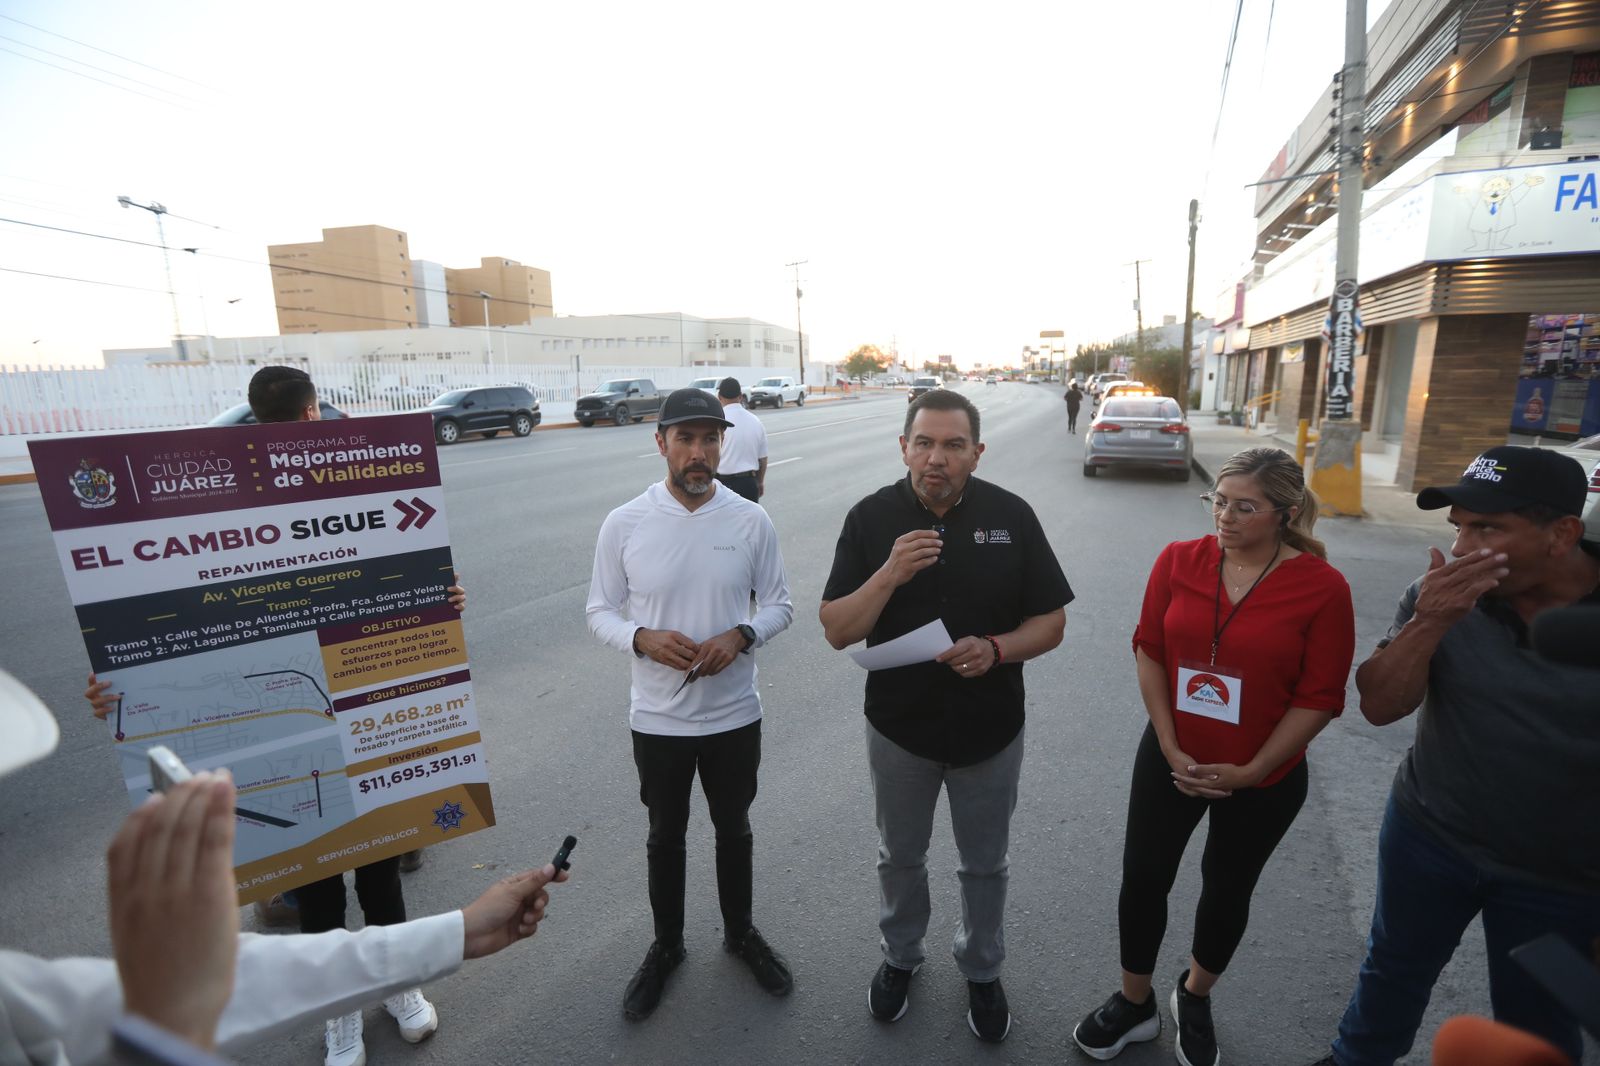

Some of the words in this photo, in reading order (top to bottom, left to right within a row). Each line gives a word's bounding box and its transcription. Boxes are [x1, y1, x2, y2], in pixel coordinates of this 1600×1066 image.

[1330, 298, 1354, 397] BARBERIA
[154, 449, 217, 461] HEROICA
[267, 436, 346, 453] PROGRAMA
[350, 435, 368, 445] DE
[270, 442, 423, 470] Mejoramiento
[146, 458, 232, 478] CIUDAD
[274, 472, 304, 488] de
[309, 460, 426, 485] Vialidades
[1473, 471, 1503, 482] solo
[150, 473, 237, 494] JUÁREZ
[70, 545, 124, 571] EL
[133, 523, 281, 562] CAMBIO
[290, 509, 387, 540] SIGUE
[197, 547, 359, 581] REPAVIMENTACIÓN
[202, 591, 227, 604] Av.
[231, 580, 292, 598] Vicente
[296, 568, 362, 588] Guerrero
[104, 638, 148, 654] Tramo
[151, 636, 162, 645] 1:
[165, 629, 198, 642] Calle
[201, 623, 232, 635] Valle
[235, 619, 252, 629] De
[255, 610, 299, 625] Allende
[312, 600, 350, 615] Profra.
[351, 597, 374, 608] Fca.
[376, 590, 412, 602] Gómez
[414, 583, 445, 595] Veleta
[266, 597, 312, 612] Tramo:
[108, 650, 152, 665] Tramo
[156, 647, 168, 656] 2:
[172, 642, 191, 652] Av.
[194, 633, 240, 648] Laguna
[243, 628, 260, 638] De
[262, 617, 317, 634] Tamiahua
[329, 610, 356, 621] Calle
[358, 602, 395, 616] Parque
[397, 598, 411, 608] De
[414, 593, 446, 605] Juárez
[361, 615, 421, 634] OBJETIVO
[340, 638, 399, 656] Concentrar
[401, 632, 429, 643] todos
[431, 628, 446, 637] los
[342, 650, 392, 667] esfuerzos
[394, 645, 417, 657] para
[419, 638, 449, 651] lograr
[333, 664, 378, 679] cambios
[380, 660, 393, 669] en
[395, 655, 420, 667] poco
[423, 645, 460, 659] tiempo.
[367, 687, 397, 703] ¿Qué
[399, 676, 447, 694] hicimos?
[204, 712, 230, 722] Vicente
[232, 707, 262, 718] Guerrero
[350, 702, 443, 736] 29,468.28
[354, 740, 389, 755] fresado
[390, 739, 397, 747] y
[398, 730, 432, 744] carpeta
[433, 719, 468, 734] asfáltica
[359, 736, 373, 745] De
[375, 724, 418, 741] superficie
[427, 717, 447, 728] base
[449, 713, 460, 721] de
[388, 745, 439, 765] Inversión
[358, 753, 477, 795] $11,695,391.91
[316, 841, 370, 865] SERVICIOS
